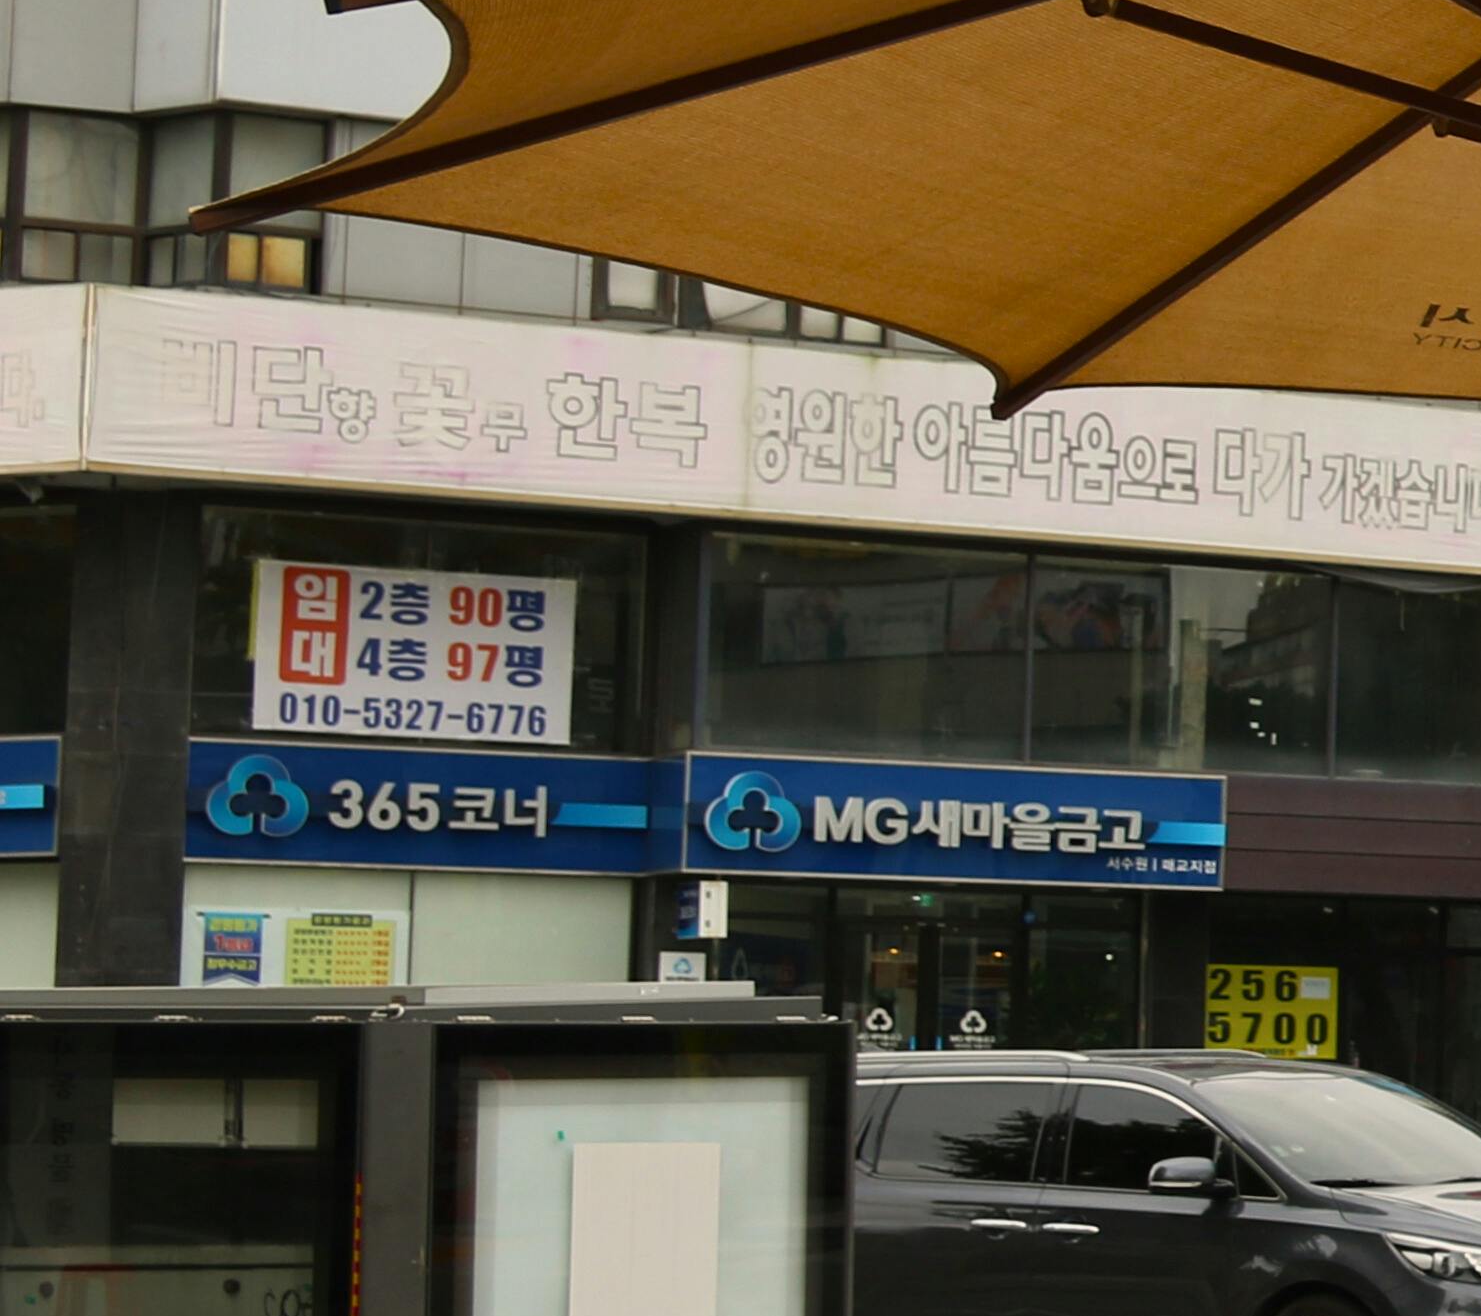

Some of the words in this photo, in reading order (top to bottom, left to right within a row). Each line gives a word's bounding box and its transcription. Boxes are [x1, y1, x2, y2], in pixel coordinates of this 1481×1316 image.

[546, 372, 708, 469] 한복
[751, 385, 904, 488] 영원한
[912, 401, 1199, 506] 아름다움으로
[290, 573, 338, 678] 임대
[359, 581, 430, 626] 2층
[449, 585, 546, 633] 90평
[356, 638, 427, 682] 4층
[446, 641, 545, 689] 97평
[279, 691, 547, 737] 010-5327-6776
[1209, 968, 1298, 1002] 256
[1207, 1011, 1328, 1045] 5700
